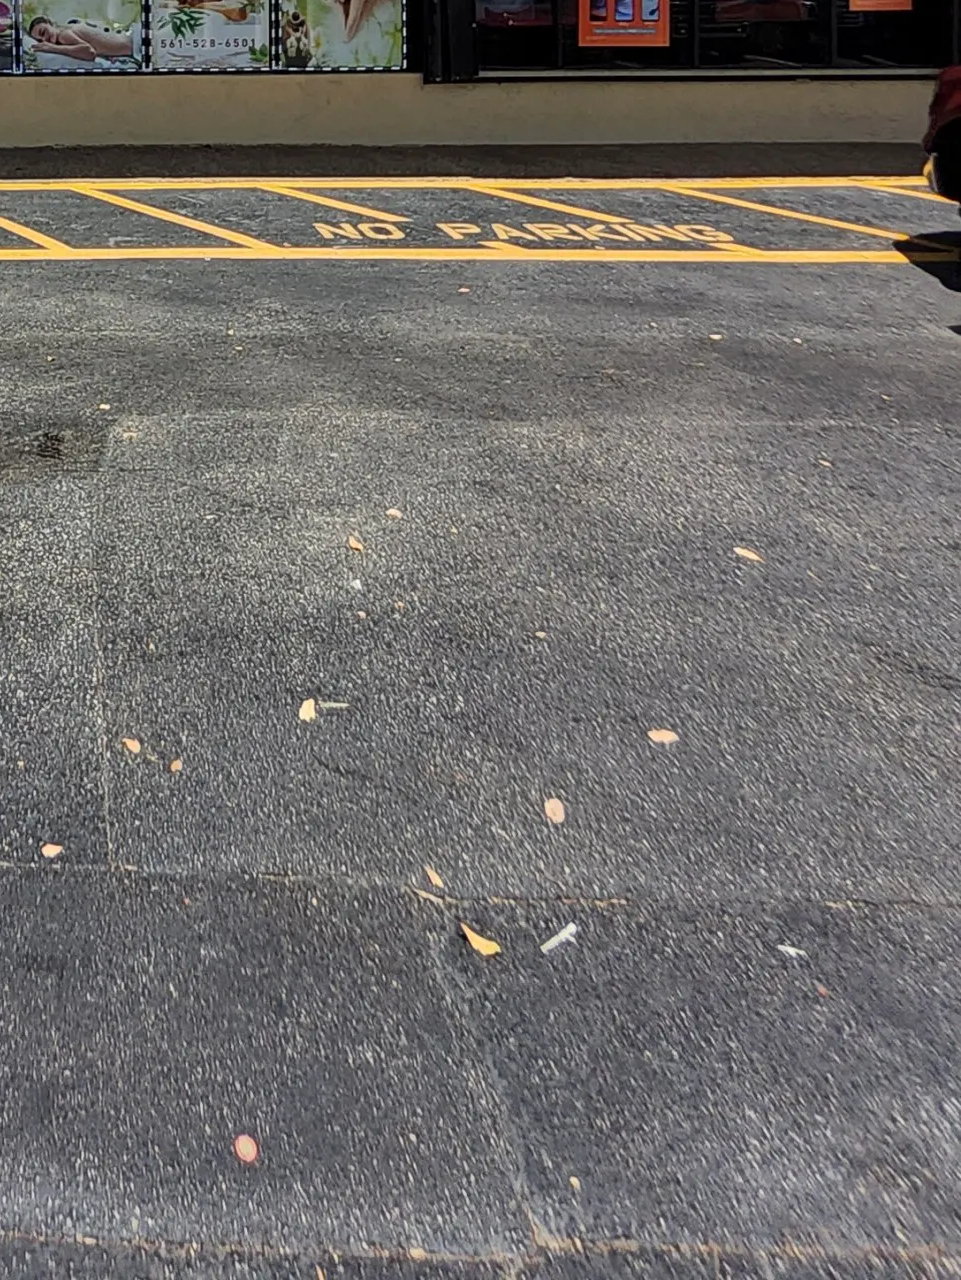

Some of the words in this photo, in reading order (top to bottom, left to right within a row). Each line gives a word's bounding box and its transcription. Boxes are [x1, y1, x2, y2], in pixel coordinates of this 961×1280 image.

[160, 37, 257, 50] 561-528-6501
[313, 221, 407, 241] NO
[436, 221, 735, 244] PARKING
